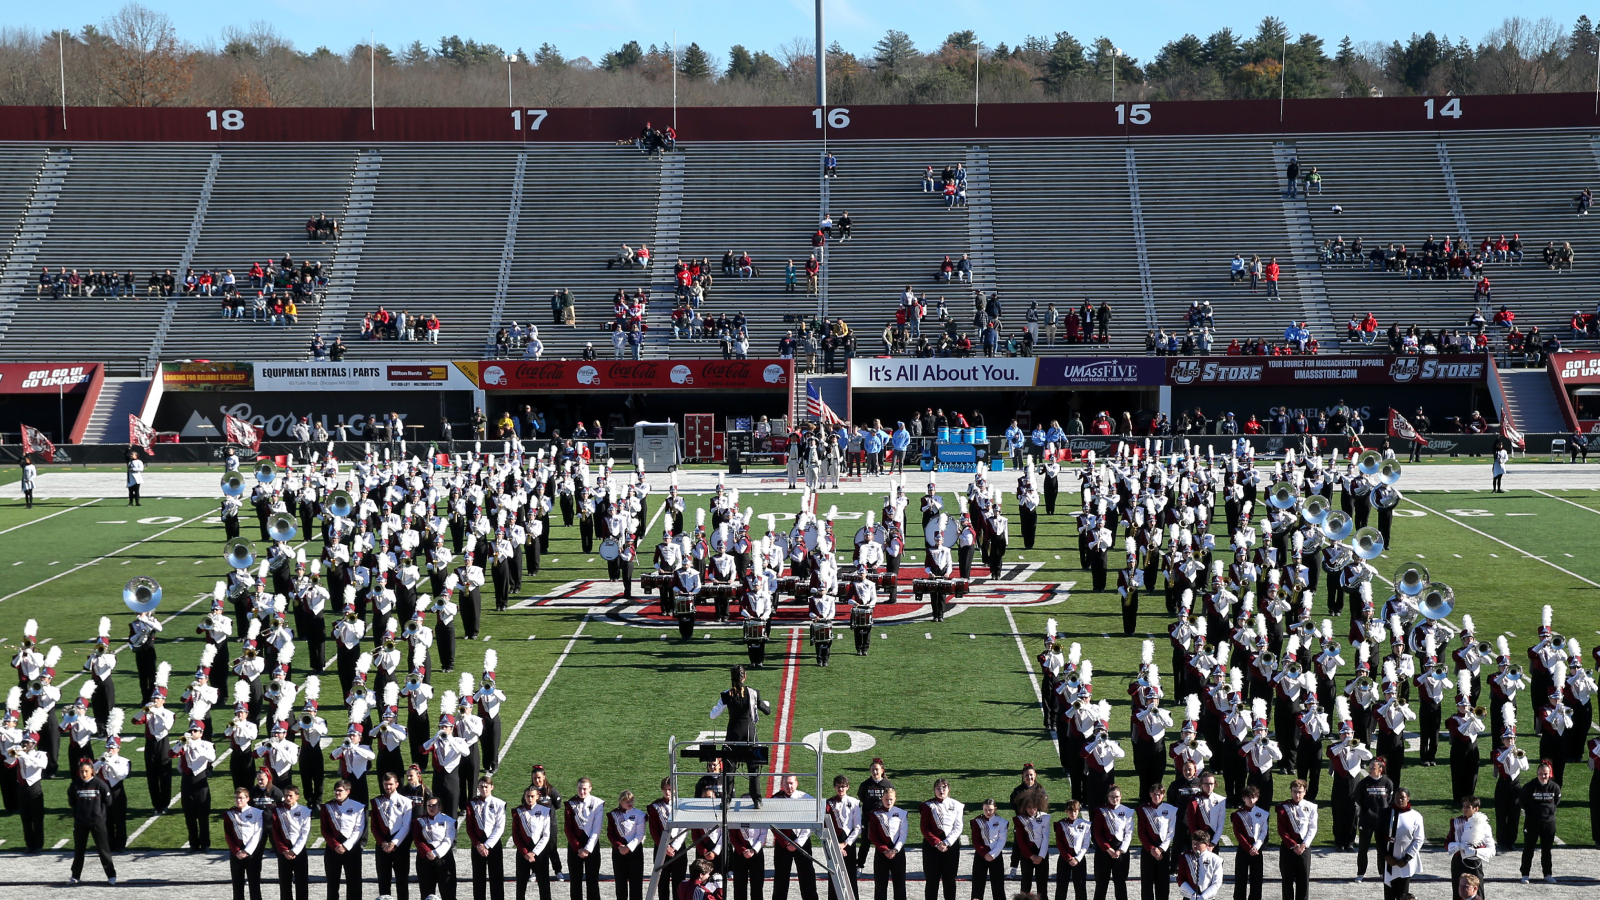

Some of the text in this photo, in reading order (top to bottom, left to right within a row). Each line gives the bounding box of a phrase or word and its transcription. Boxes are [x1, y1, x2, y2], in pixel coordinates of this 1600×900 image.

[1115, 103, 1151, 125] 15
[1424, 98, 1463, 119] 14
[206, 109, 245, 130] 18
[511, 109, 548, 130] 17
[812, 108, 850, 129] 16
[515, 362, 566, 380] Coca-Cola
[609, 362, 660, 379] Coca-Cola
[702, 361, 753, 379] Coca-Cola
[1268, 360, 1283, 368] YOUR
[1283, 360, 1304, 368] SOURCE
[1316, 359, 1361, 367] MASSACHUSETTS
[1361, 358, 1384, 366] APPAREL
[1566, 358, 1600, 370] GO! G
[28, 367, 83, 379] GO! GO U!
[262, 367, 380, 378] EQUIPMENT RENTALS PARTS
[869, 364, 1020, 381] It's All About You.
[1294, 369, 1358, 379] UMASSSTORE.COM
[1562, 369, 1578, 379] GO
[22, 374, 90, 389] GO UMASS!
[1064, 440, 1106, 449] #FLAGSHIP
